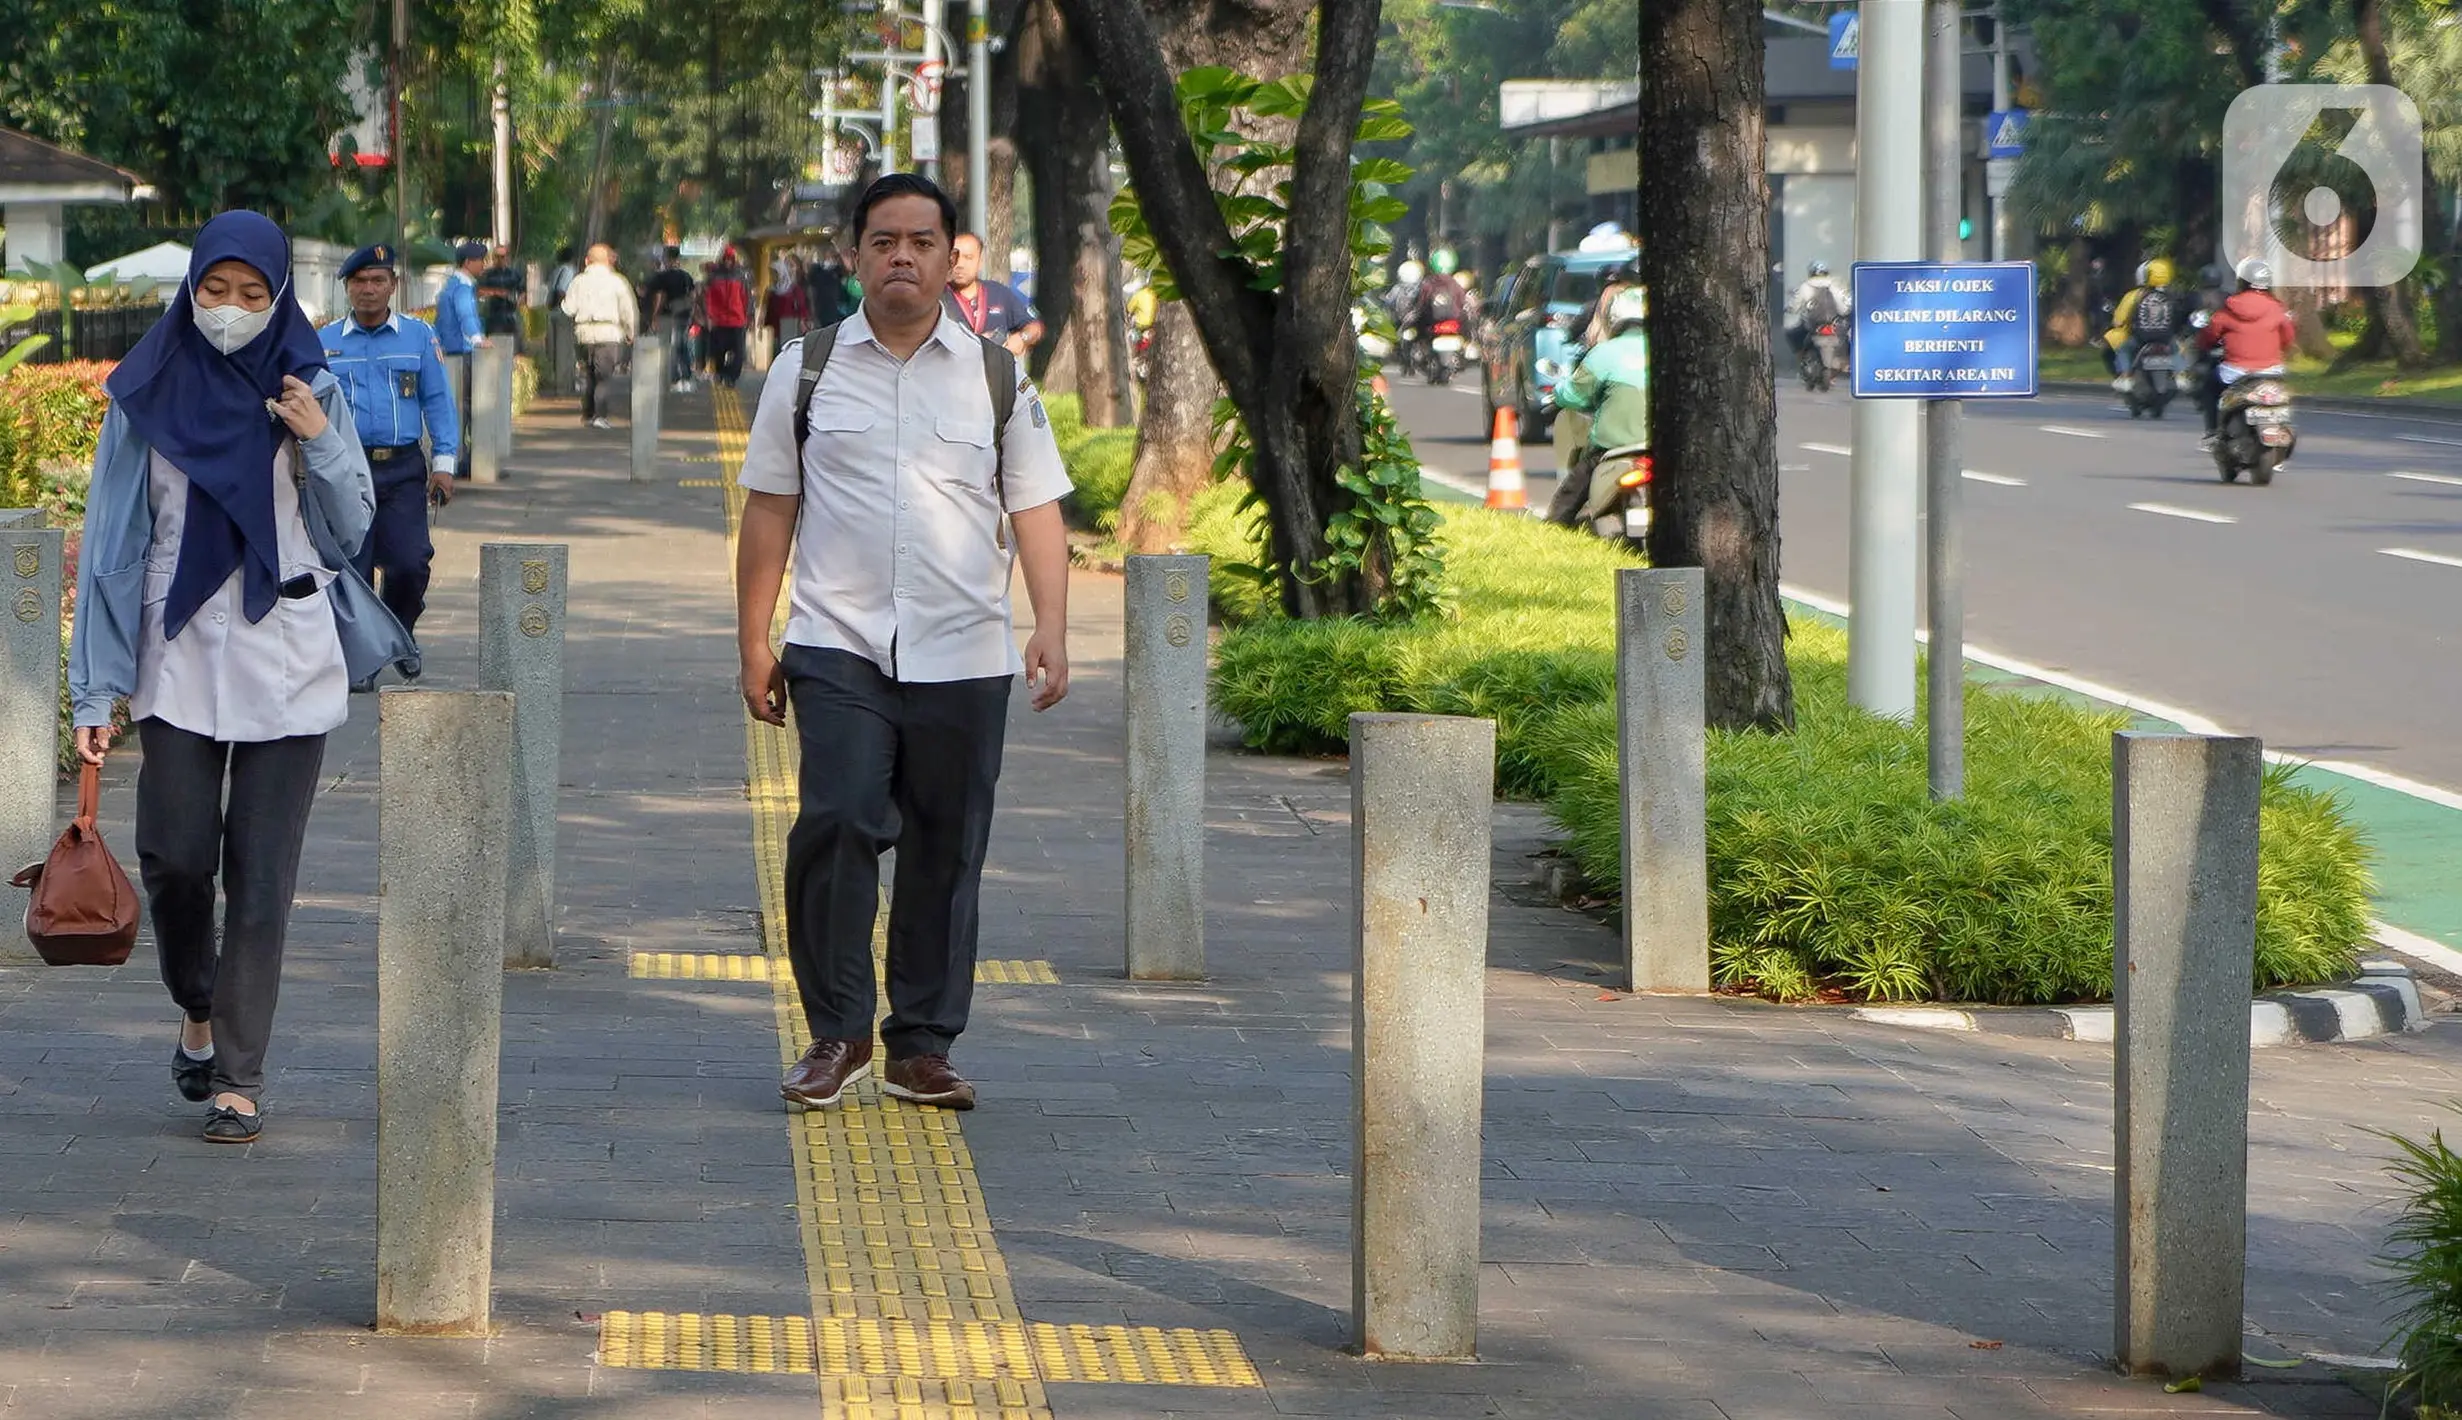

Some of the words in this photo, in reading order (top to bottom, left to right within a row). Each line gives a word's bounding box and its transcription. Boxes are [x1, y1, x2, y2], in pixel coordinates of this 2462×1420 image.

[1894, 280, 1941, 293] TAKSI
[1952, 279, 1994, 292] OJEK
[1870, 310, 1932, 323] ONLINE
[1935, 309, 2017, 322] DILARANG
[1904, 340, 1984, 353] BERHENTI
[1874, 368, 1942, 381] SEKITAR
[1945, 368, 1989, 381] AREA
[1991, 368, 2015, 381] INI
